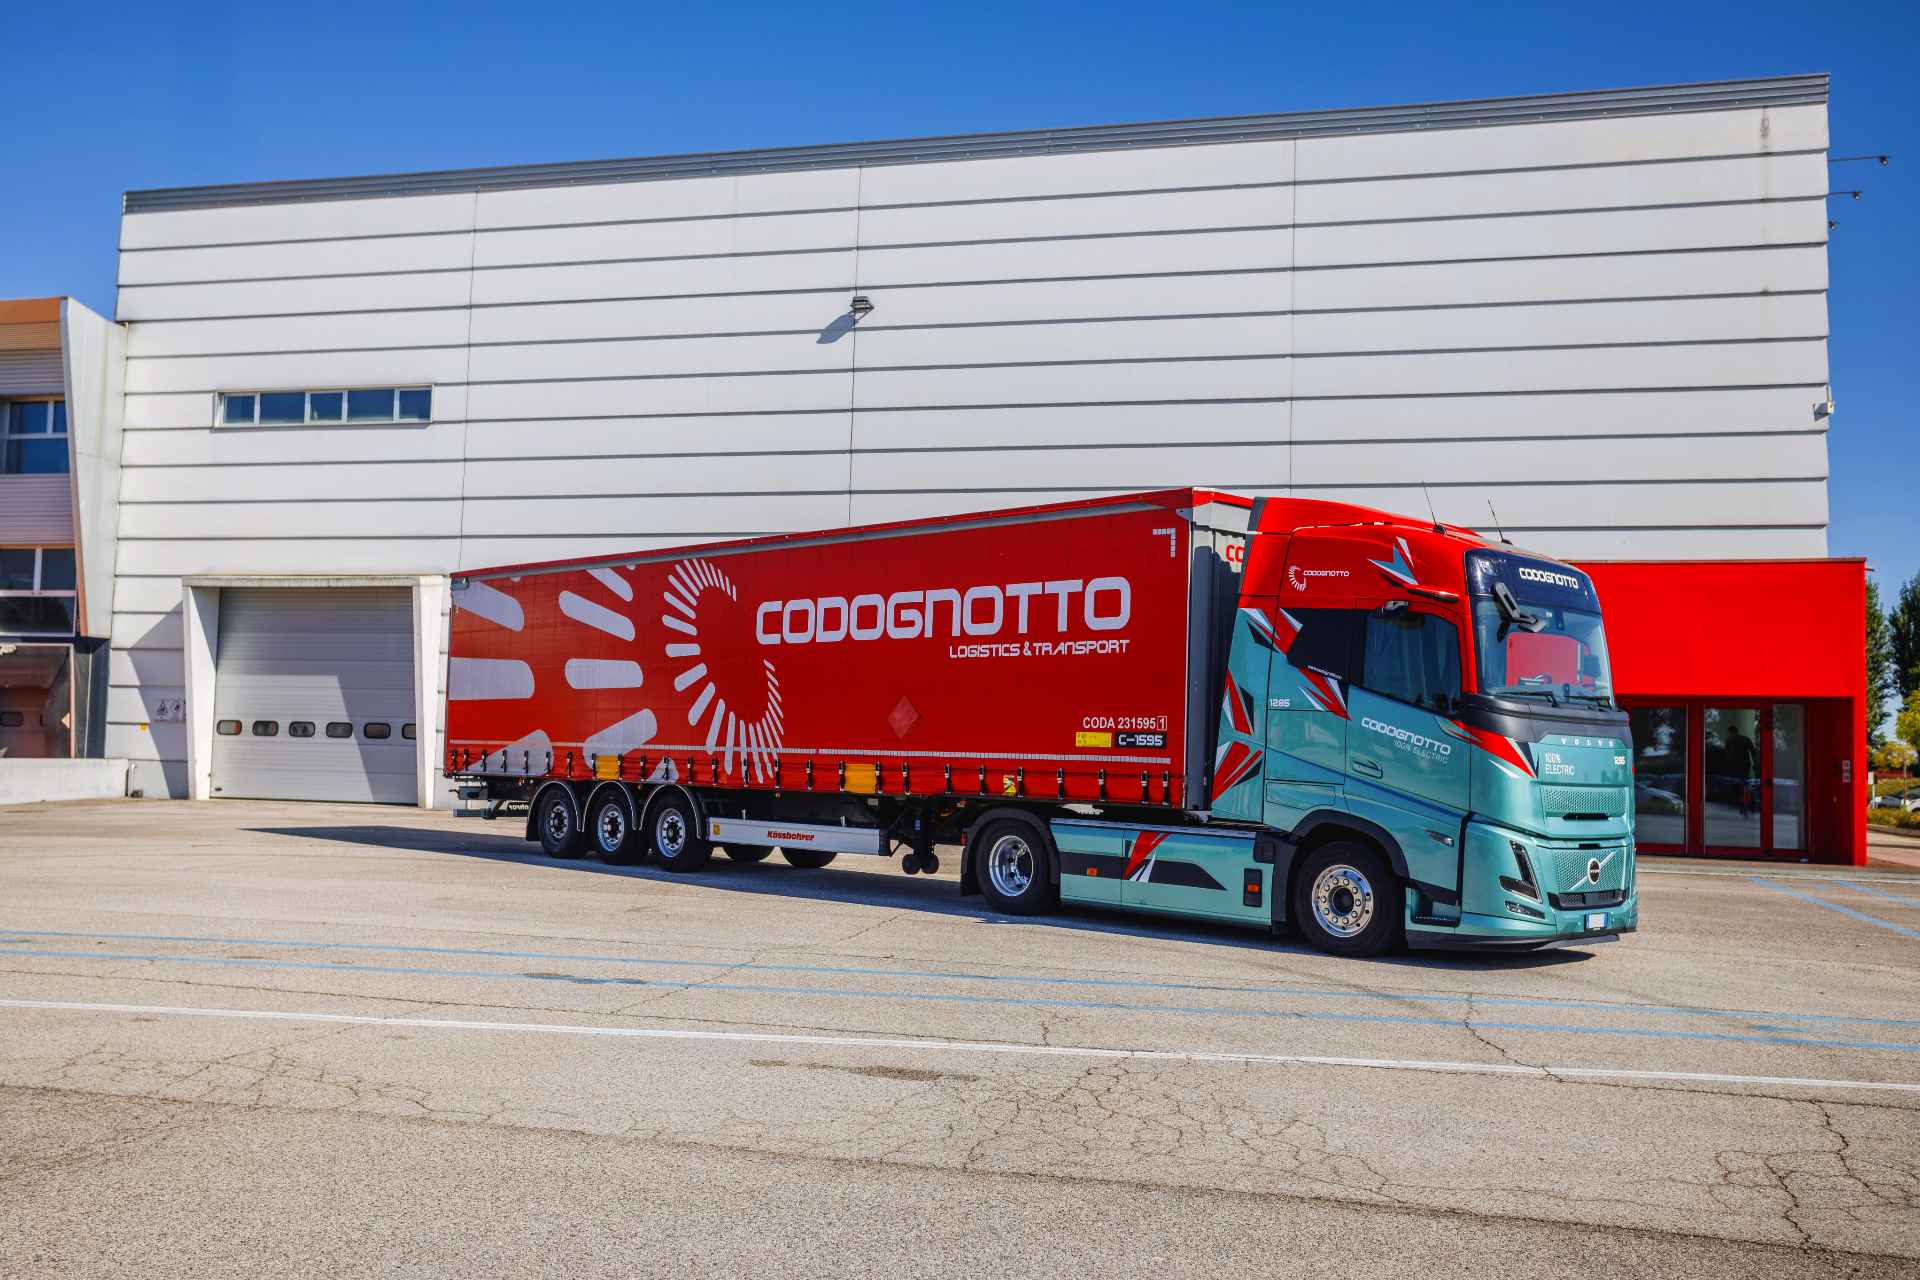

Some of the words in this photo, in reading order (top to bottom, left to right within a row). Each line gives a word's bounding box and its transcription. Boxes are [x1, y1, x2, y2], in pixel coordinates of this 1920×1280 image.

[1303, 569, 1350, 577] CODOGNOTTO
[1519, 567, 1578, 589] CODOGNOTTO
[756, 576, 1131, 645] CODOGNOTTO
[949, 643, 1020, 659] LOGISTICS
[1269, 698, 1290, 708] 1285
[1082, 716, 1115, 729] CODA
[1117, 716, 1156, 729] 231595
[1118, 734, 1163, 746] C-1595
[1361, 716, 1451, 756] CODOGNOTTO
[1545, 764, 1575, 776] ELECTRIC
